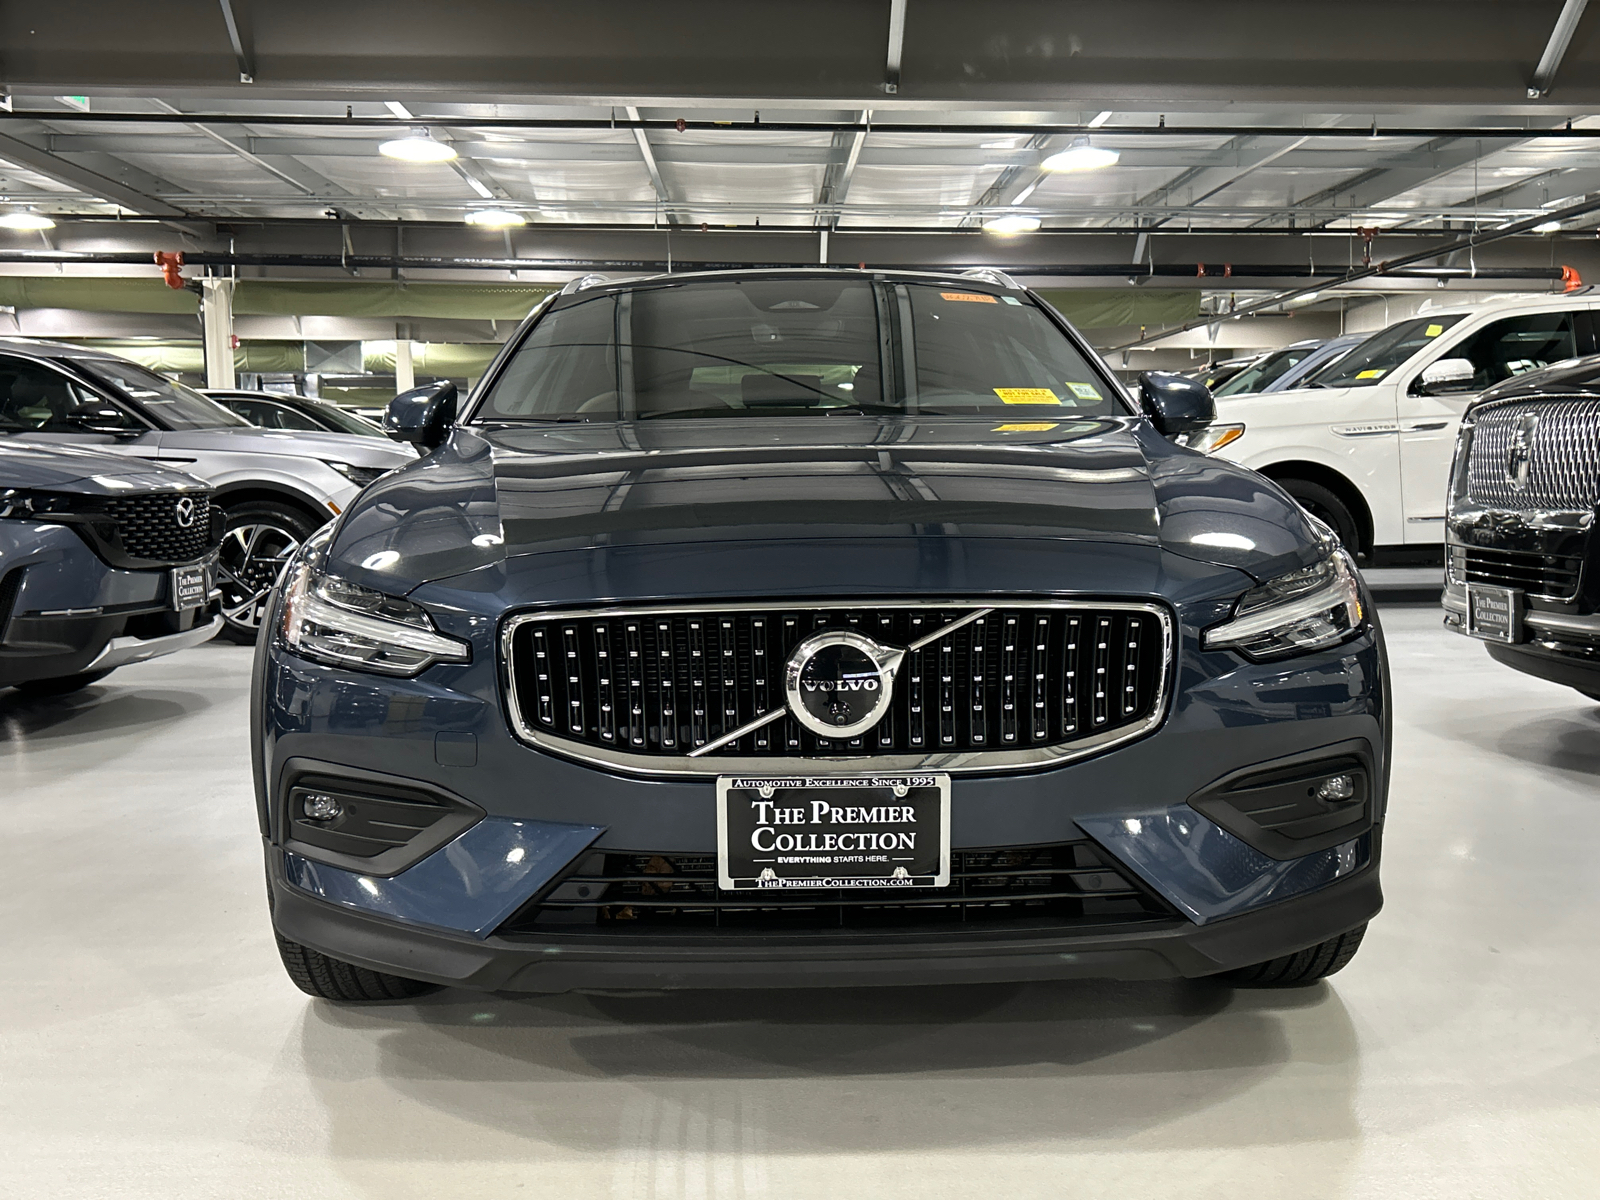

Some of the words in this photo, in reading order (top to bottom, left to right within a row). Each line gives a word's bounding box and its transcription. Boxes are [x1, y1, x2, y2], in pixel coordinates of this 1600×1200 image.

[1476, 608, 1508, 624] COLLECTION
[802, 679, 878, 692] VOLVO
[734, 778, 804, 788] AUTOMOTIVE
[805, 778, 868, 787] EXCELLENCE
[871, 778, 902, 787] SINCE
[906, 776, 934, 786] 1995
[752, 800, 806, 825] THE
[810, 800, 916, 824] PREMIER
[751, 826, 916, 852] COLLECTION
